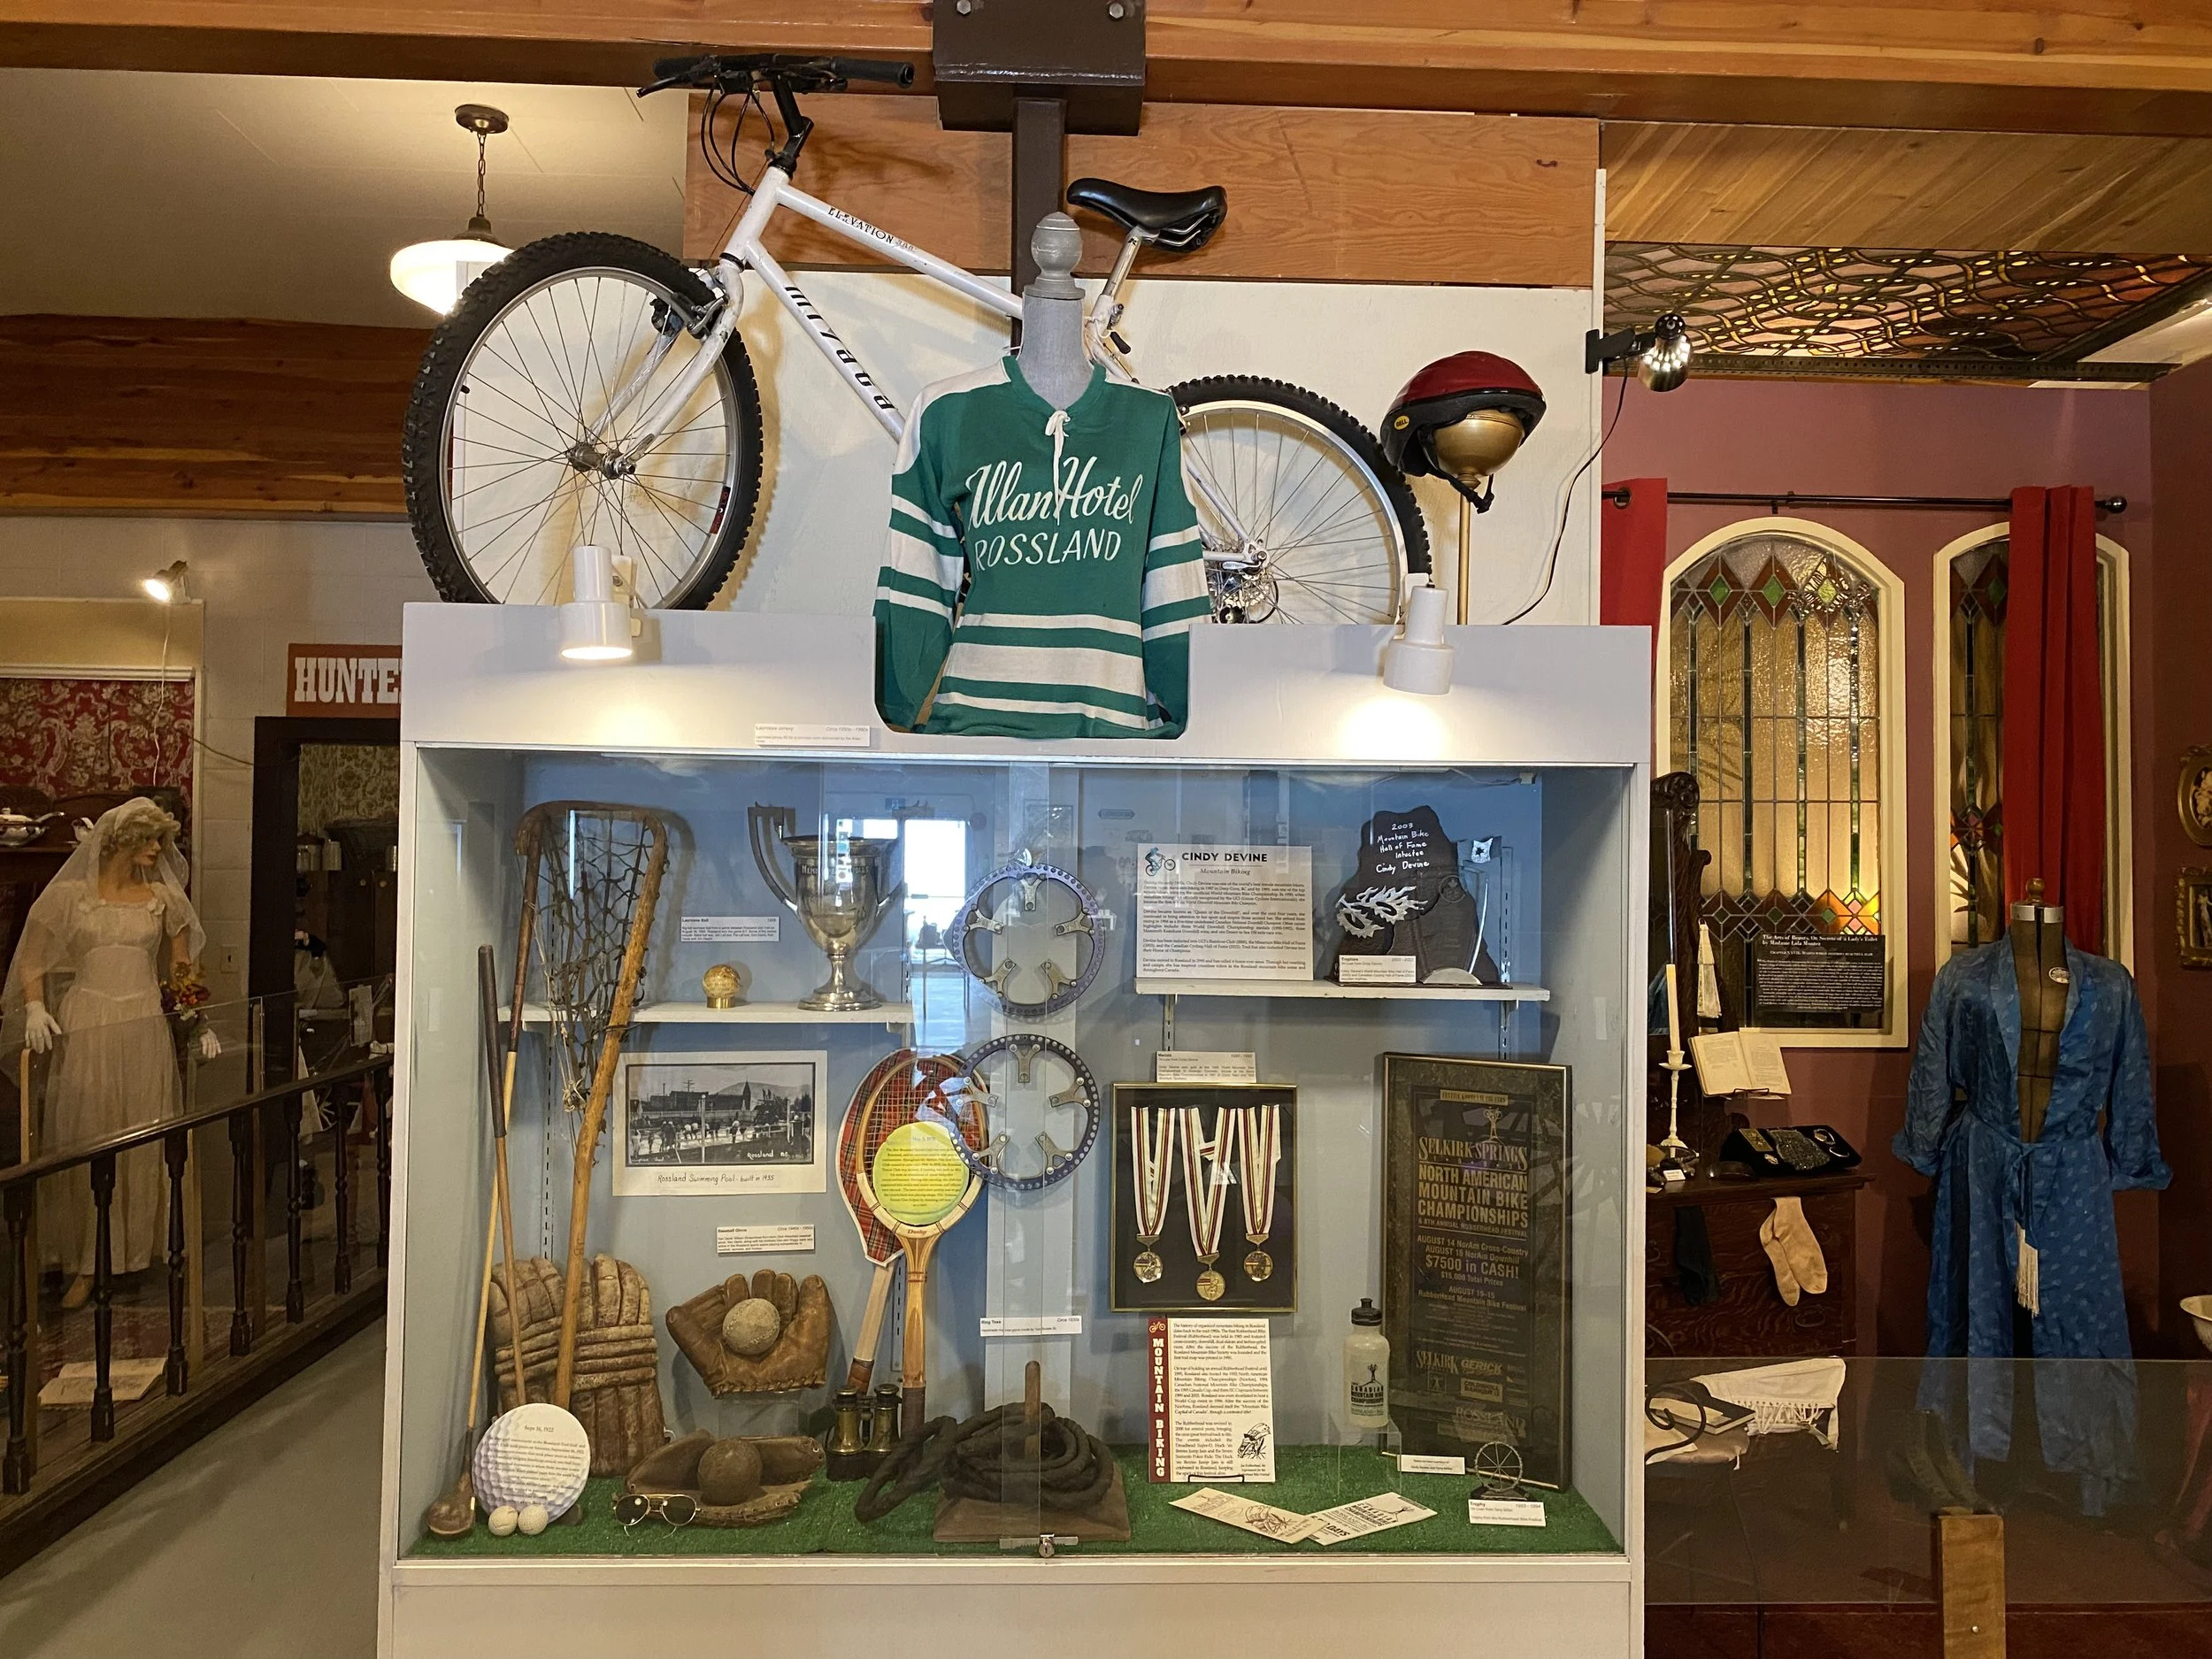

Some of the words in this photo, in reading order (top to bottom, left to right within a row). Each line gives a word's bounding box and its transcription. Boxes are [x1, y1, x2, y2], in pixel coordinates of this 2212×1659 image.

[828, 207, 895, 244] ELEVATION
[1053, 456, 1143, 525] Hotel
[974, 528, 1121, 571] ROSSLAND
[295, 657, 403, 703] HUNTE
[1377, 833, 1409, 845] Mountain
[1411, 830, 1430, 839] Bike
[1391, 822, 1413, 831] 2003
[1181, 852, 1219, 861] CINDY
[1224, 853, 1268, 863] DEVINE
[1379, 844, 1393, 854] Hall
[1376, 863, 1396, 875] Cindy
[1402, 858, 1430, 870] Devine
[747, 1150, 774, 1159] Rossland
[1418, 1137, 1473, 1160] SELKIRK
[1474, 1142, 1528, 1171] SPRINGS
[657, 1172, 687, 1183] Rossland
[688, 1174, 718, 1185] Swimming
[720, 1173, 735, 1182] Pool
[1418, 1164, 1459, 1184] NORTH
[1463, 1169, 1528, 1191] AMERICAN
[1418, 1182, 1490, 1205] MOUNTAIN
[1496, 1191, 1528, 1210] BIKE
[1418, 1200, 1528, 1228] CHAMPIONSHIPS
[1436, 1220, 1459, 1229] ANNUAL
[1501, 1227, 1528, 1238] FESTIVAL
[1417, 1235, 1445, 1245] AUGUST
[1456, 1240, 1479, 1250] NorAm
[1481, 1243, 1529, 1257] Cross-Country
[1425, 1245, 1453, 1256] AUGUST
[1465, 1250, 1488, 1261] NorAm
[1490, 1254, 1520, 1264] Downhill
[1425, 1255, 1462, 1271] $7500
[1465, 1260, 1477, 1273] in
[1481, 1262, 1518, 1279] CASH!
[1449, 1286, 1475, 1295] AUGUST
[1468, 1274, 1482, 1283] Total
[1484, 1277, 1503, 1286] Prizes
[1417, 1350, 1459, 1375] SELKIRK
[1461, 1359, 1503, 1376] GERICK
[1153, 1338, 1164, 1413] MOUNTAIN
[1455, 1407, 1526, 1438] ROSSLAND
[1156, 1419, 1165, 1477] BIKING
